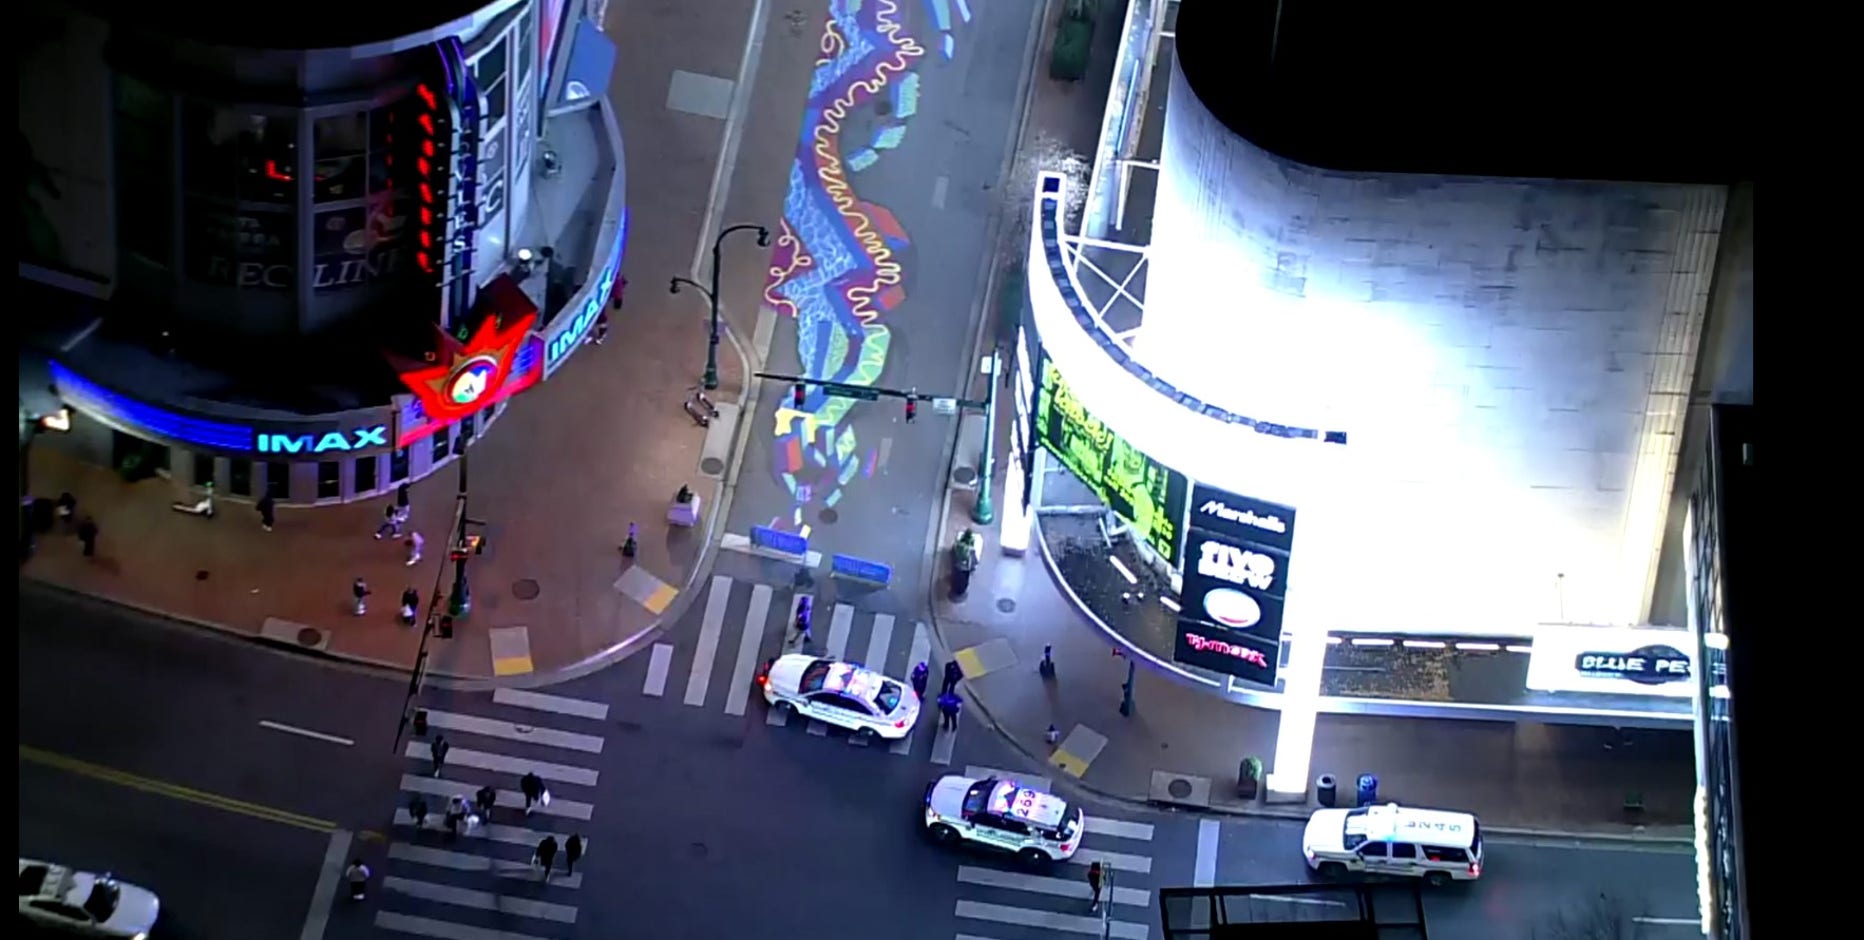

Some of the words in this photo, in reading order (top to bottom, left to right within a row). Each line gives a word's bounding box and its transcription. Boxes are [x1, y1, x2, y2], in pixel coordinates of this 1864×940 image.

[551, 270, 614, 360] IMAX
[256, 425, 387, 454] IMAX
[1200, 500, 1285, 533] Marshalls
[1581, 655, 1645, 671] BLUE
[1655, 657, 1692, 674] PE
